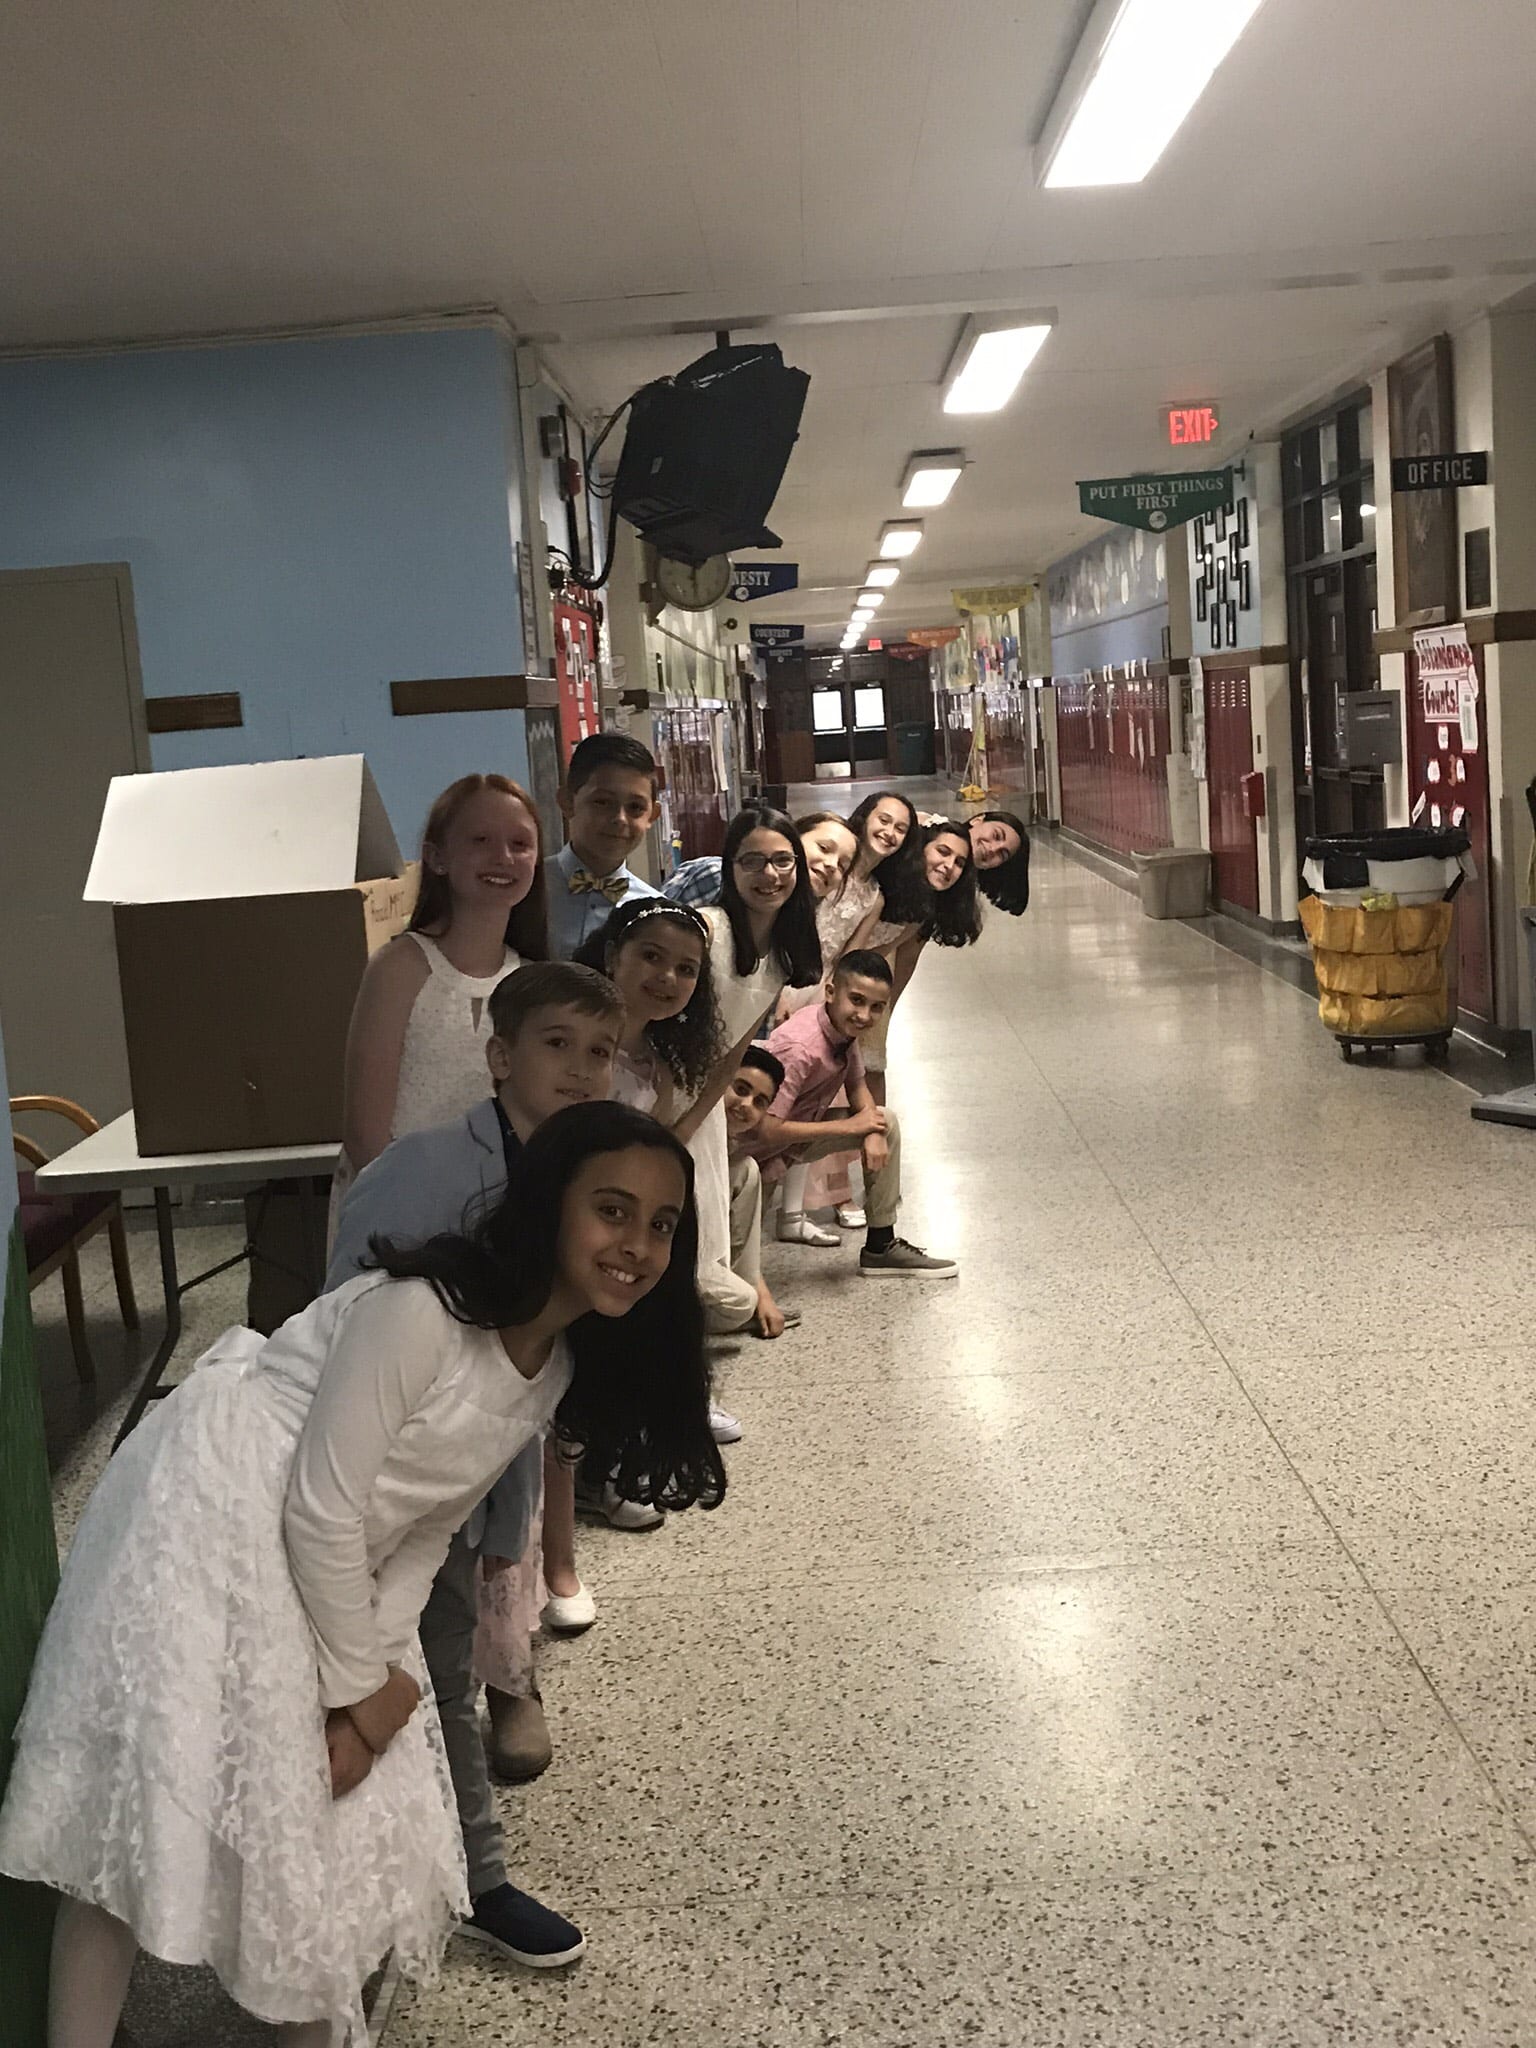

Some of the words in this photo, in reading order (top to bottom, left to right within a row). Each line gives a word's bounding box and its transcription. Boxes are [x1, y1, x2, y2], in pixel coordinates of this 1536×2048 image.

[1169, 408, 1212, 445] EXIT
[1408, 458, 1473, 484] OFFICE
[1090, 485, 1118, 500] PUT
[1122, 481, 1164, 497] FIRST
[1168, 477, 1225, 494] THINGS
[1137, 494, 1179, 510] FIRST
